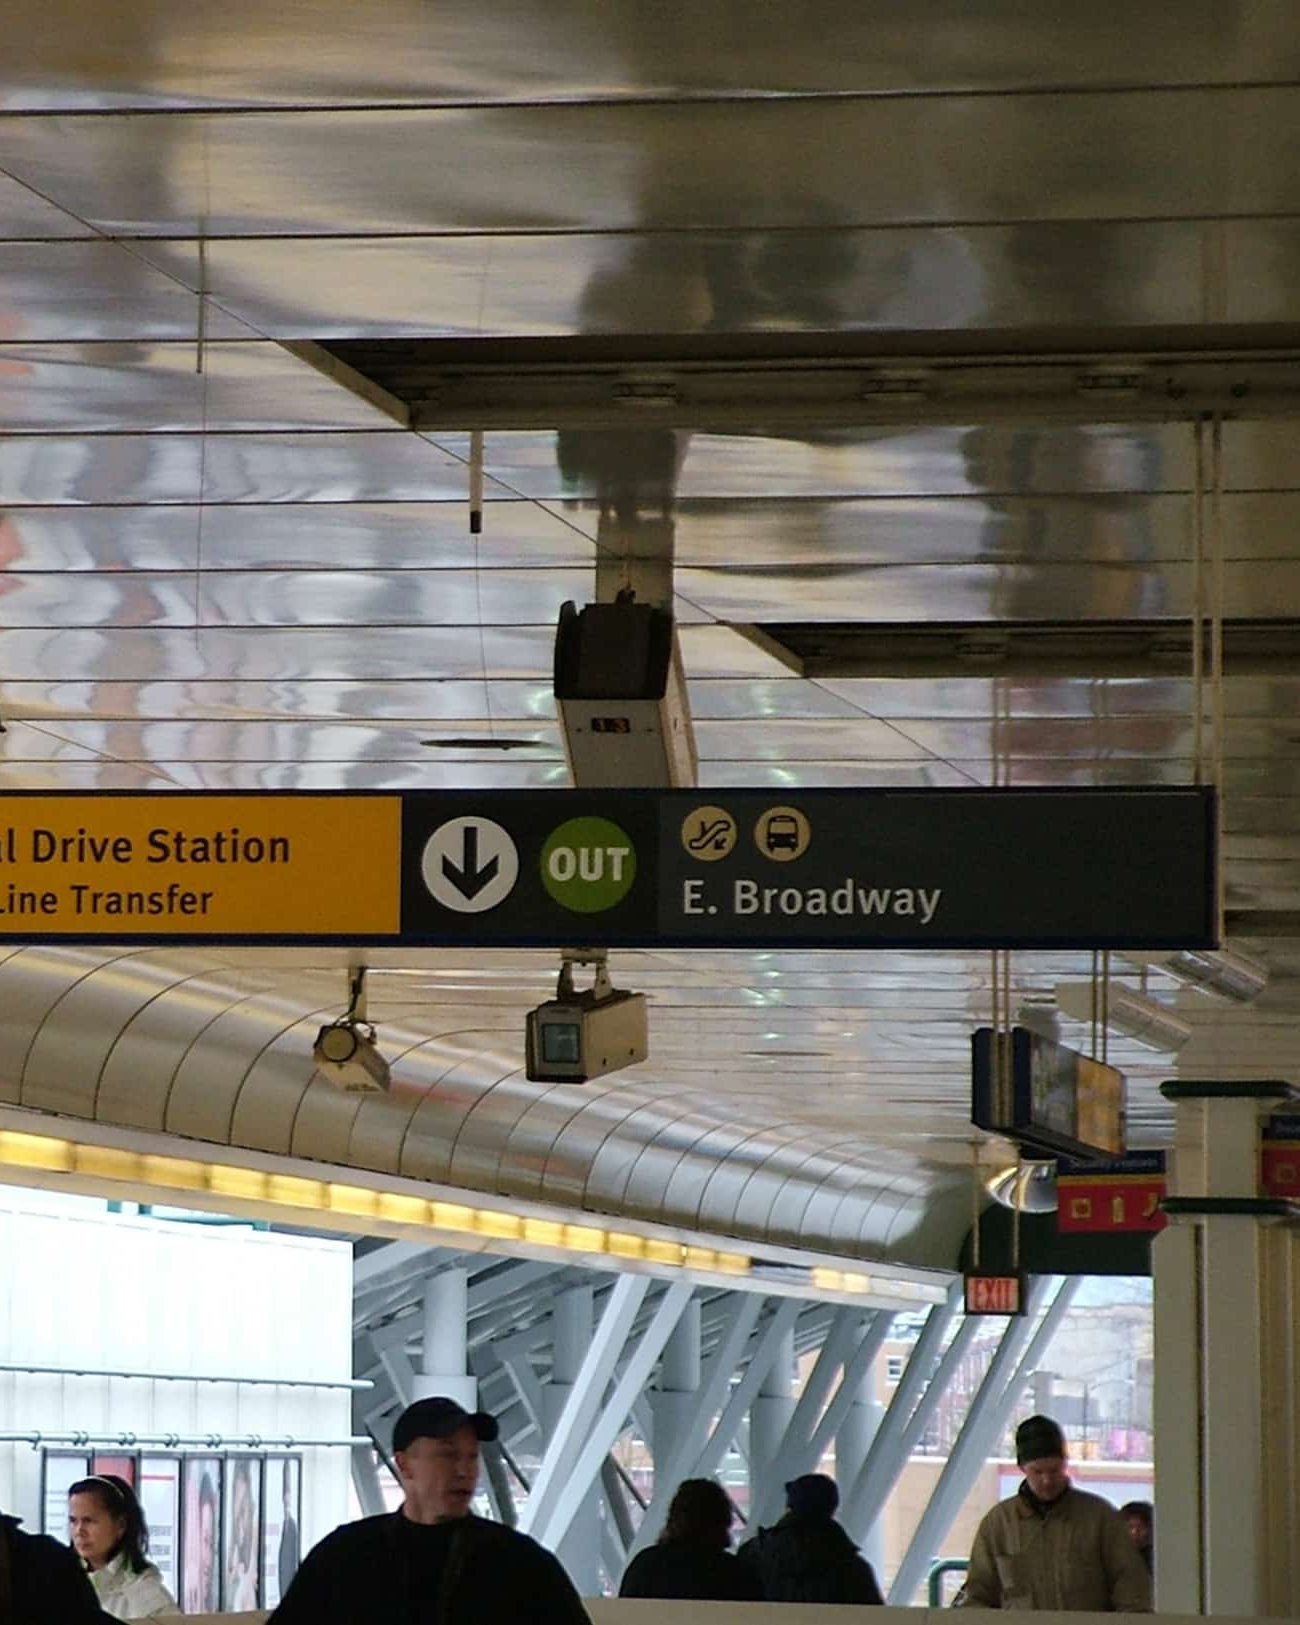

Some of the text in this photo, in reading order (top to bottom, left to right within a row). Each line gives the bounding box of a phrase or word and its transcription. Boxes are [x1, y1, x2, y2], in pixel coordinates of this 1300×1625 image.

[32, 828, 133, 863] Drive
[147, 828, 290, 863] Station
[549, 847, 630, 882] OUT
[70, 884, 213, 914] Transfer
[683, 879, 941, 924] E. Broadway
[972, 1280, 1011, 1309] EXIT
